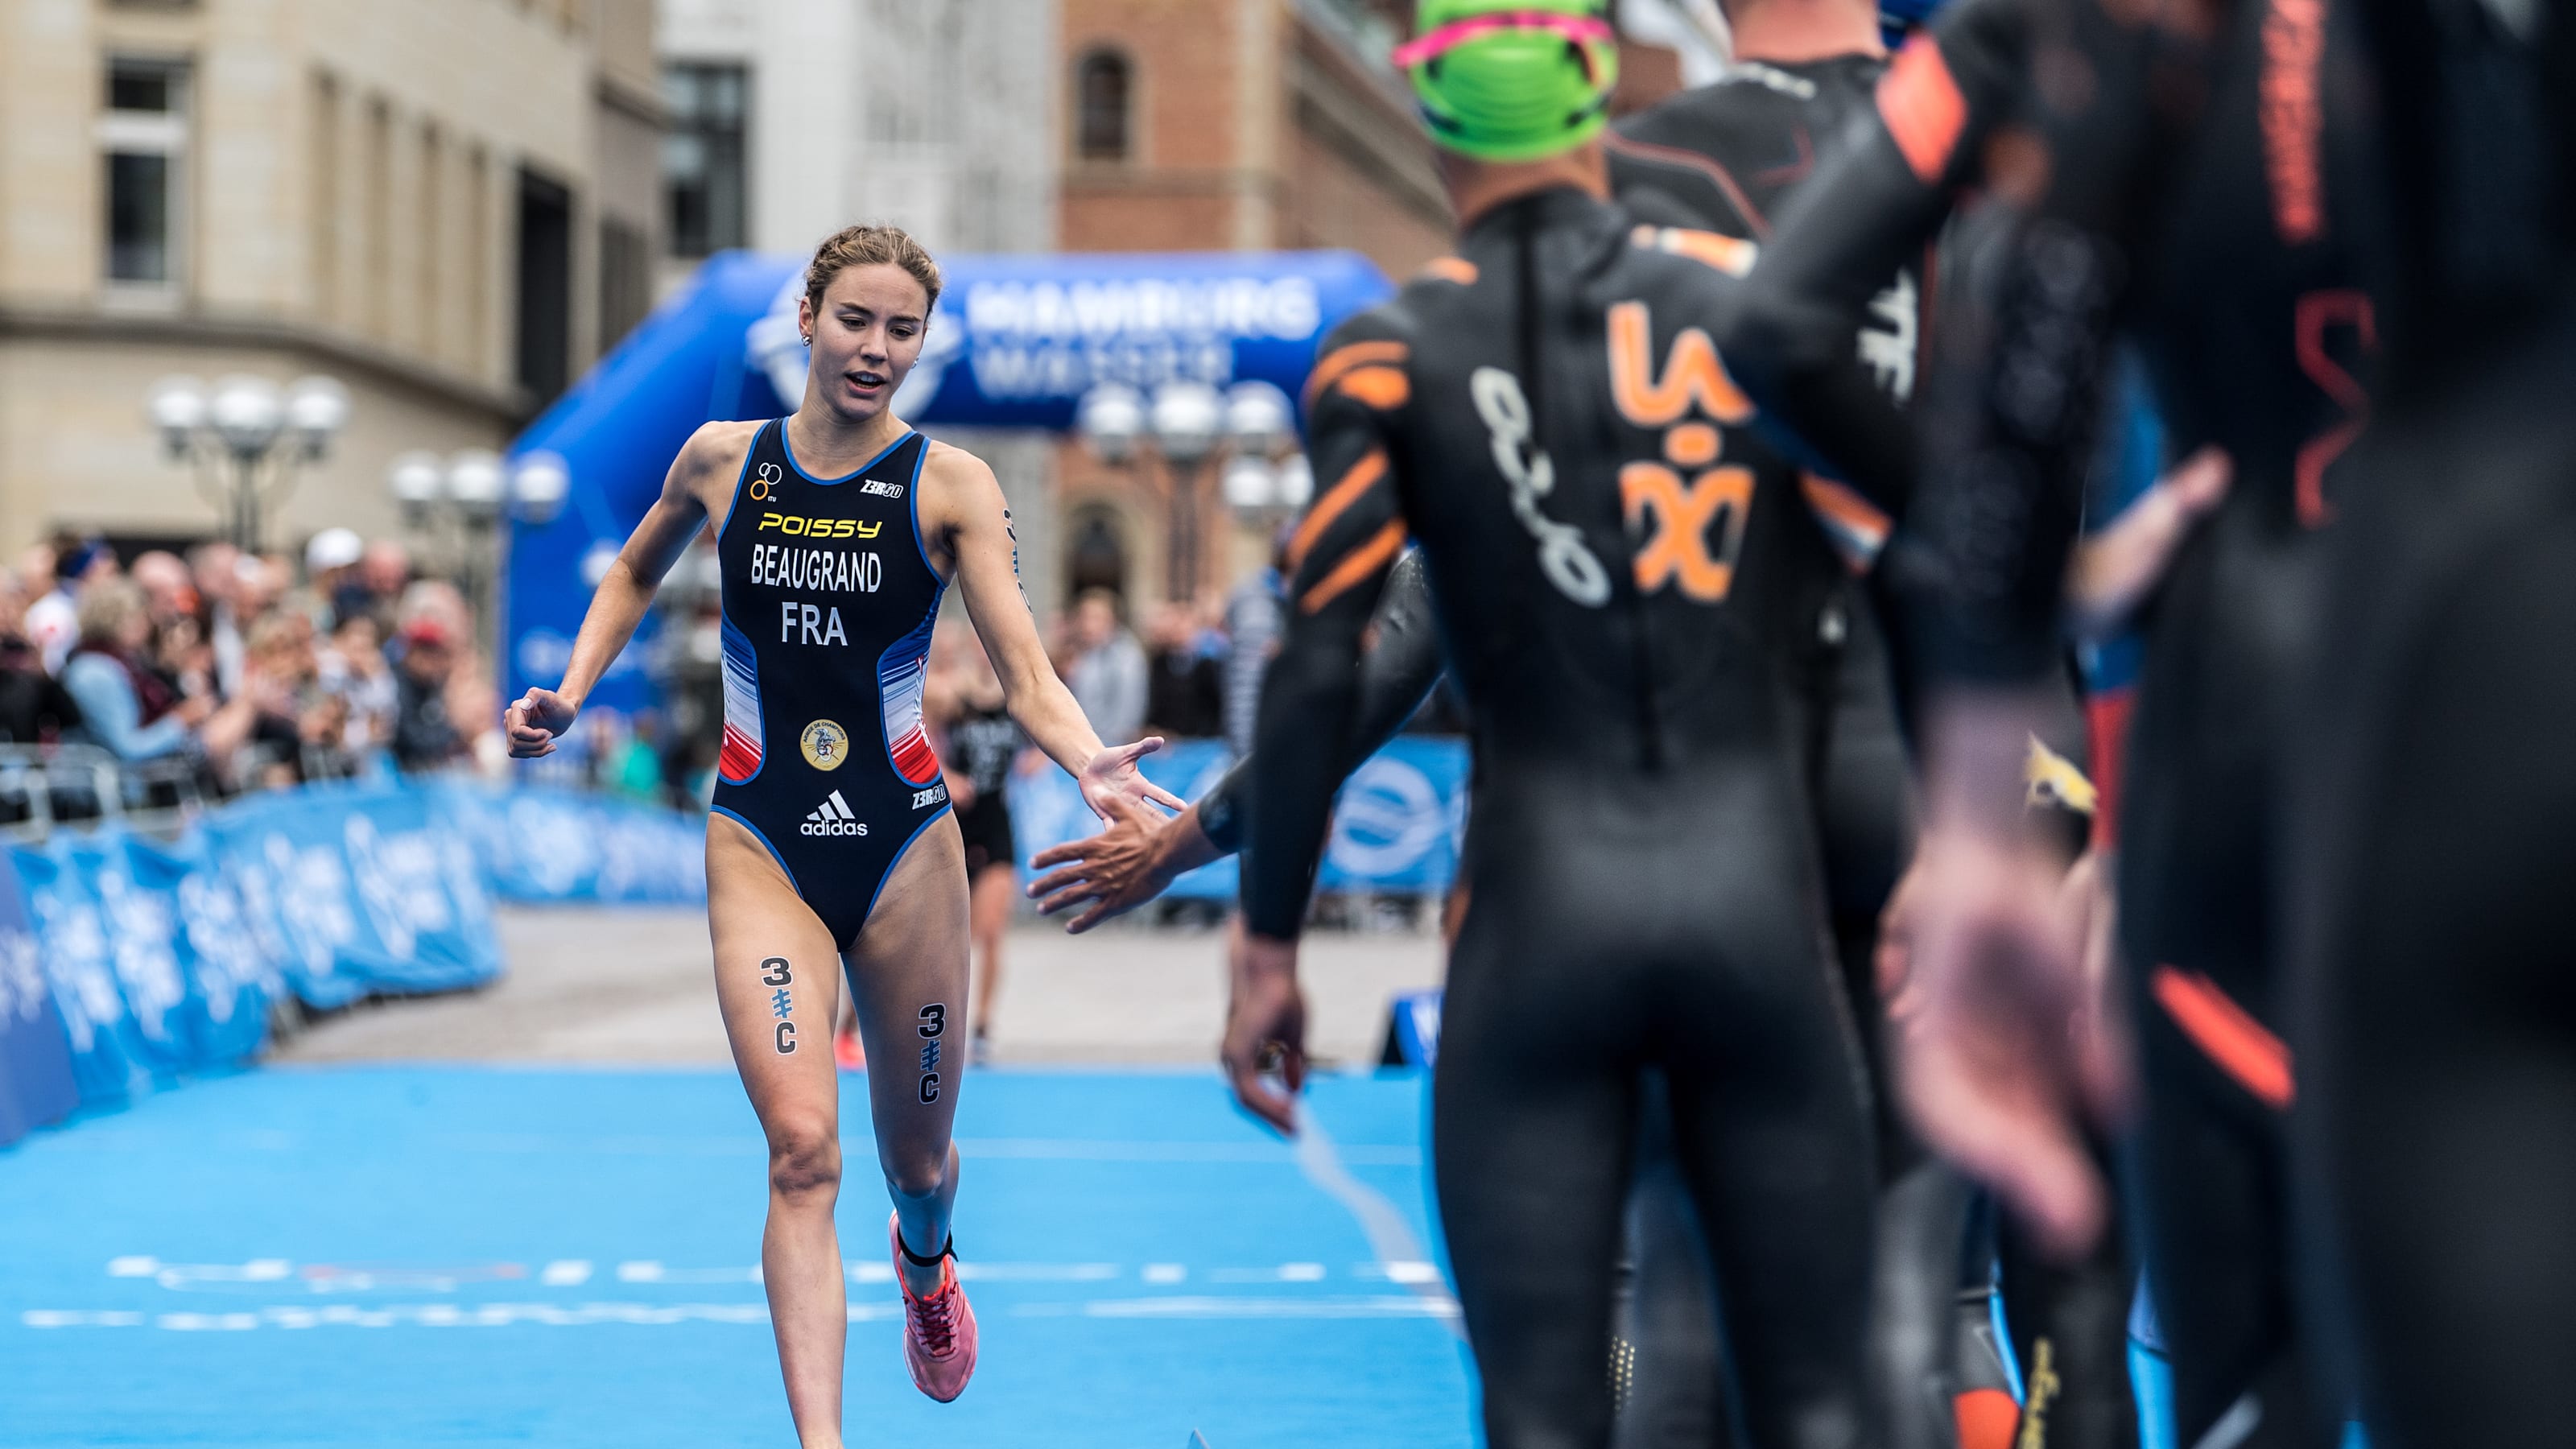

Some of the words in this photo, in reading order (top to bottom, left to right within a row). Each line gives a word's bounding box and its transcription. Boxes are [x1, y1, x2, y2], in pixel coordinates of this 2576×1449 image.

[758, 512, 883, 539] POISSY
[751, 543, 882, 593] BEAUGRAND
[781, 601, 848, 646] FRA
[799, 819, 869, 837] adidas
[759, 956, 794, 988] 3
[774, 1020, 798, 1056] C
[917, 1002, 947, 1040] 3
[918, 1071, 941, 1105] C
